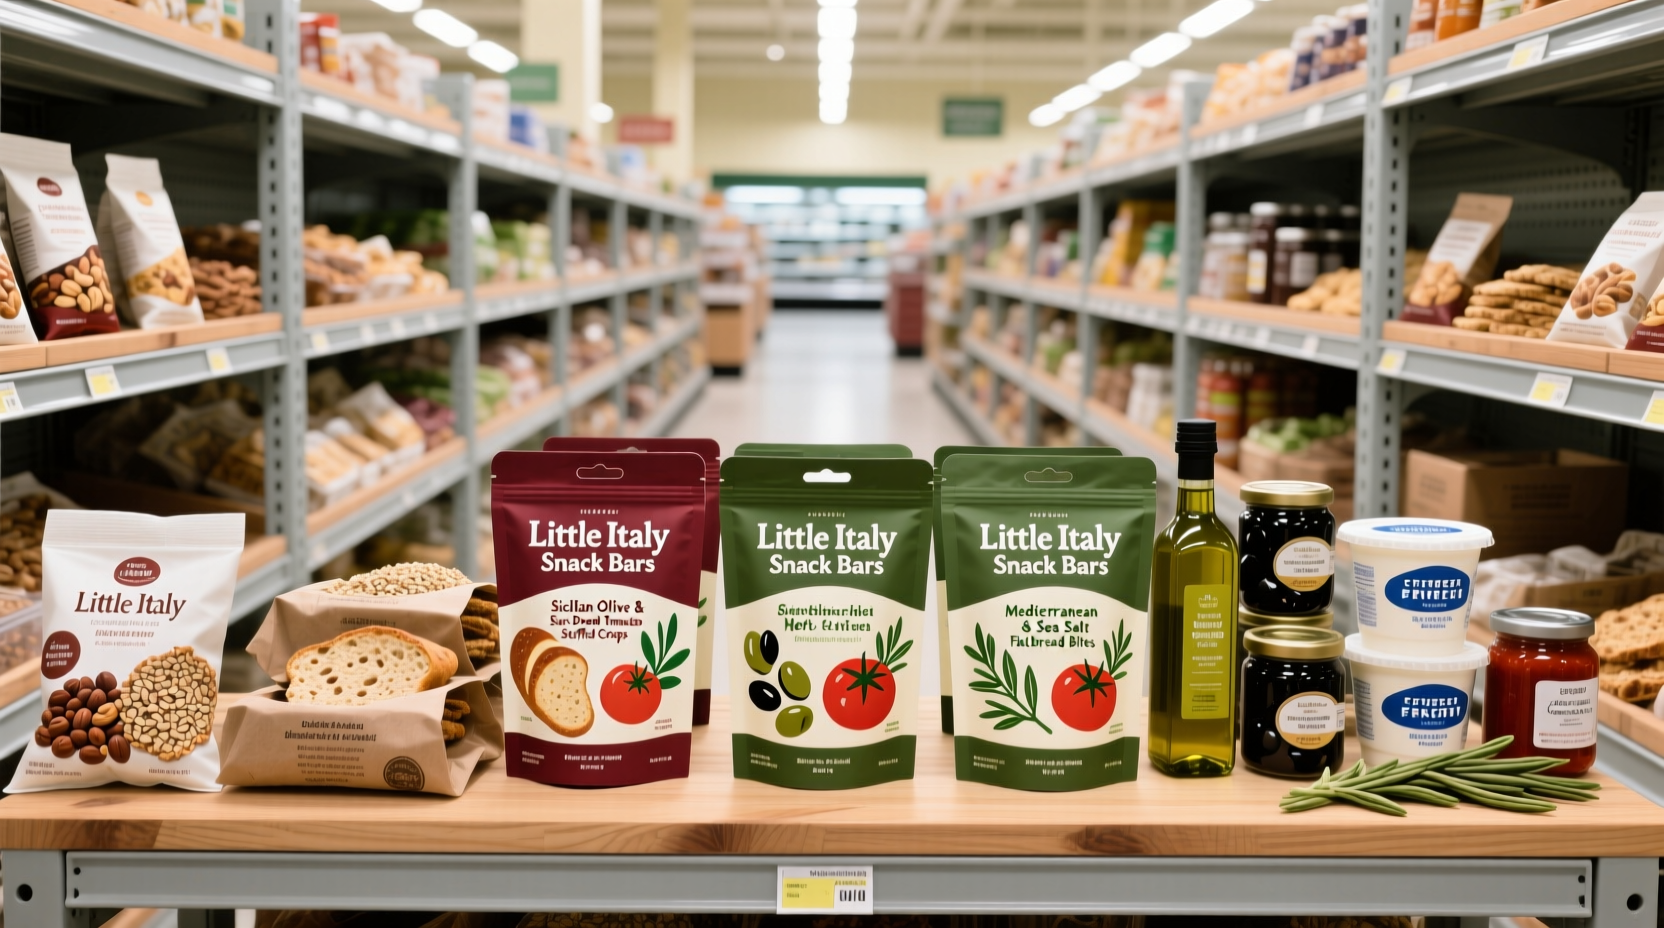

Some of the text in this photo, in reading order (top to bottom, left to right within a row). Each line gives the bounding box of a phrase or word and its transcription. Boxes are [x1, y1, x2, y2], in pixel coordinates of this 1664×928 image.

[528, 520, 671, 557] Little Italy
[757, 522, 898, 559] Little Italy
[979, 523, 1122, 559] Little Italy
[540, 551, 656, 573] Snack Bars
[769, 553, 885, 575] Snack Bars
[993, 554, 1109, 576] Snack Bars
[74, 591, 187, 622] Little Italy
[597, 599, 631, 613] Olive
[634, 600, 645, 614] &
[1021, 619, 1090, 634] & Sea Salt
